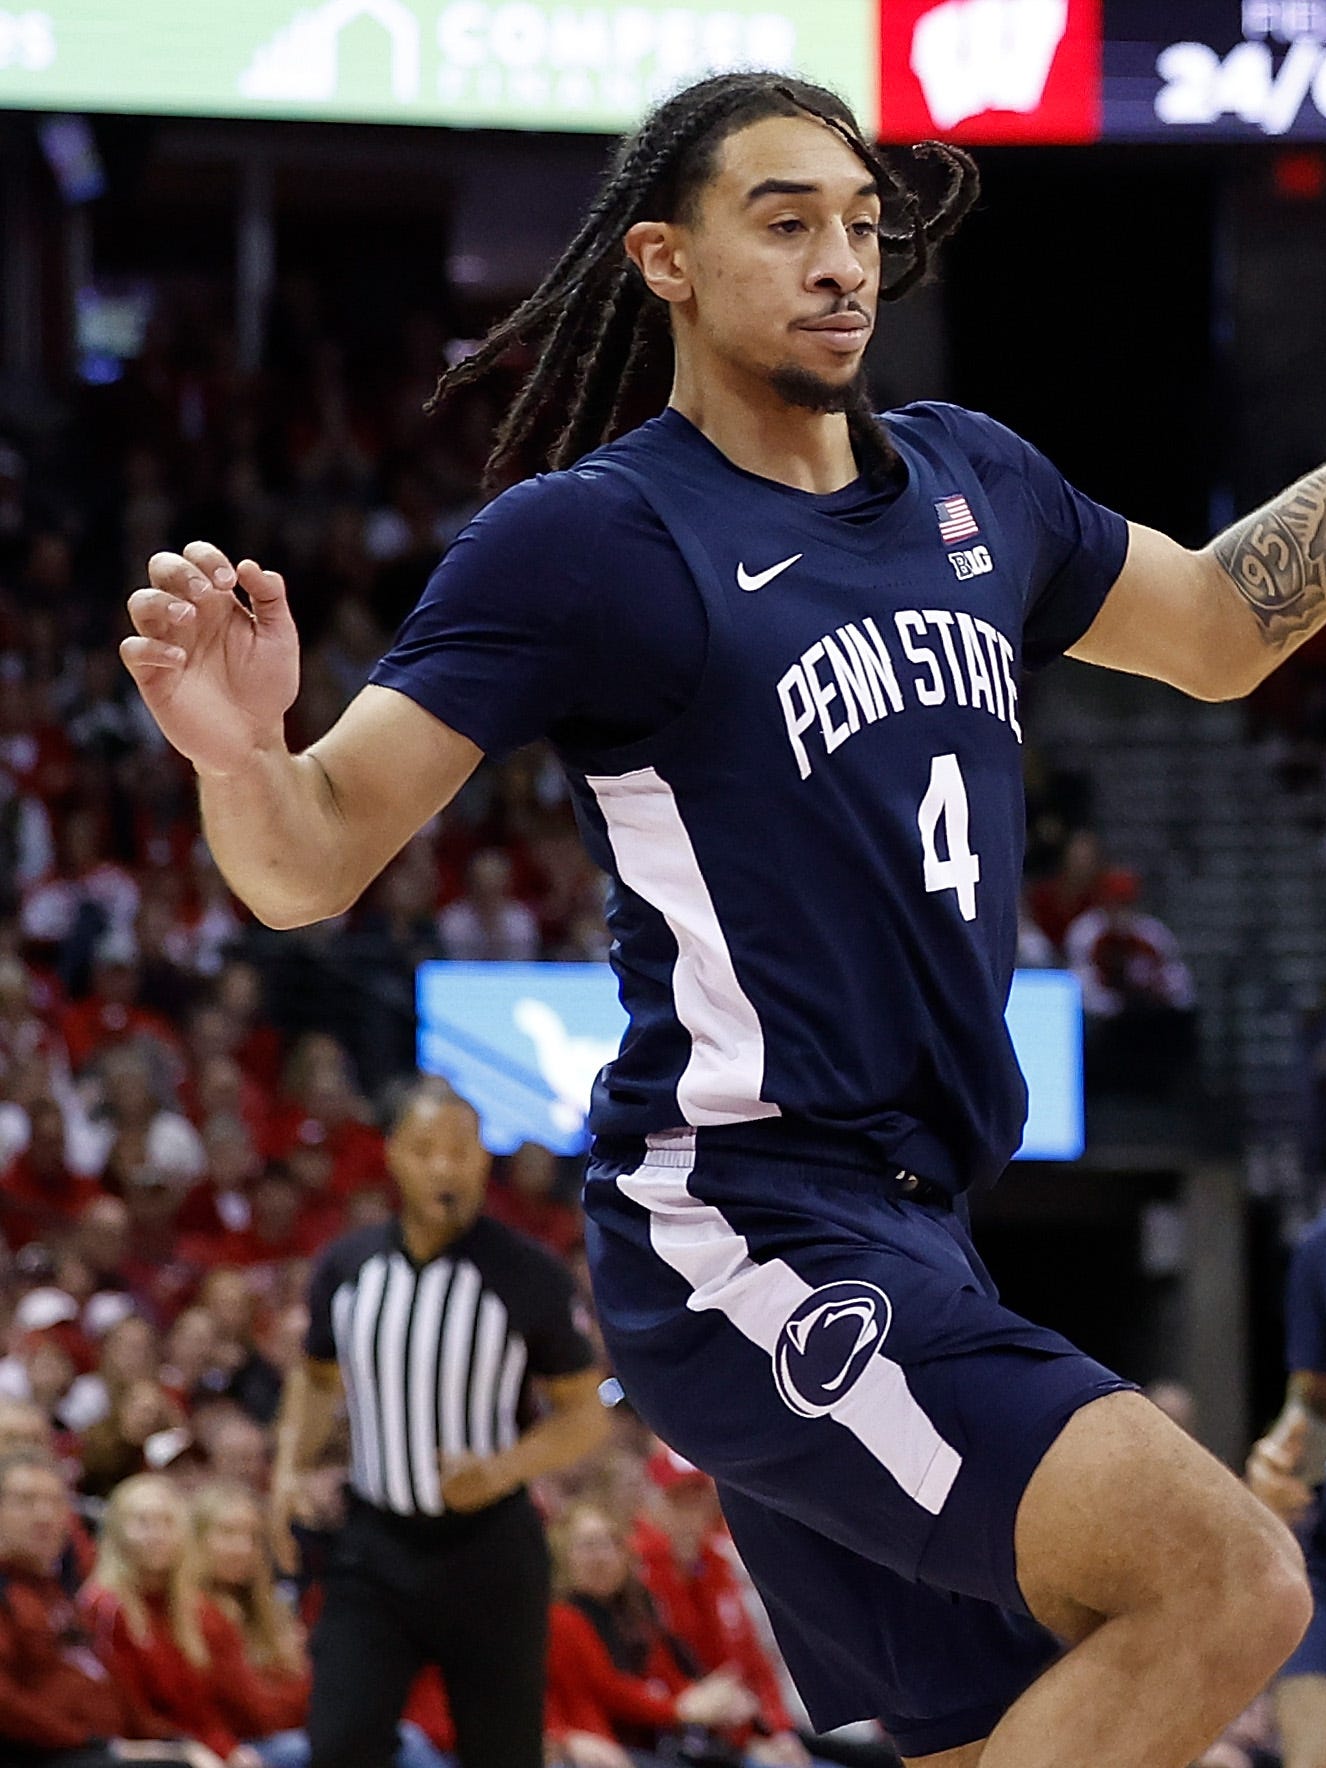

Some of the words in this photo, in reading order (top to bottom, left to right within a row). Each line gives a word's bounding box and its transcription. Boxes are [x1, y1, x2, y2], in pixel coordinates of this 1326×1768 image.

[776, 617, 905, 781] PENN
[894, 609, 1023, 744] STATE
[917, 753, 980, 922] 4
